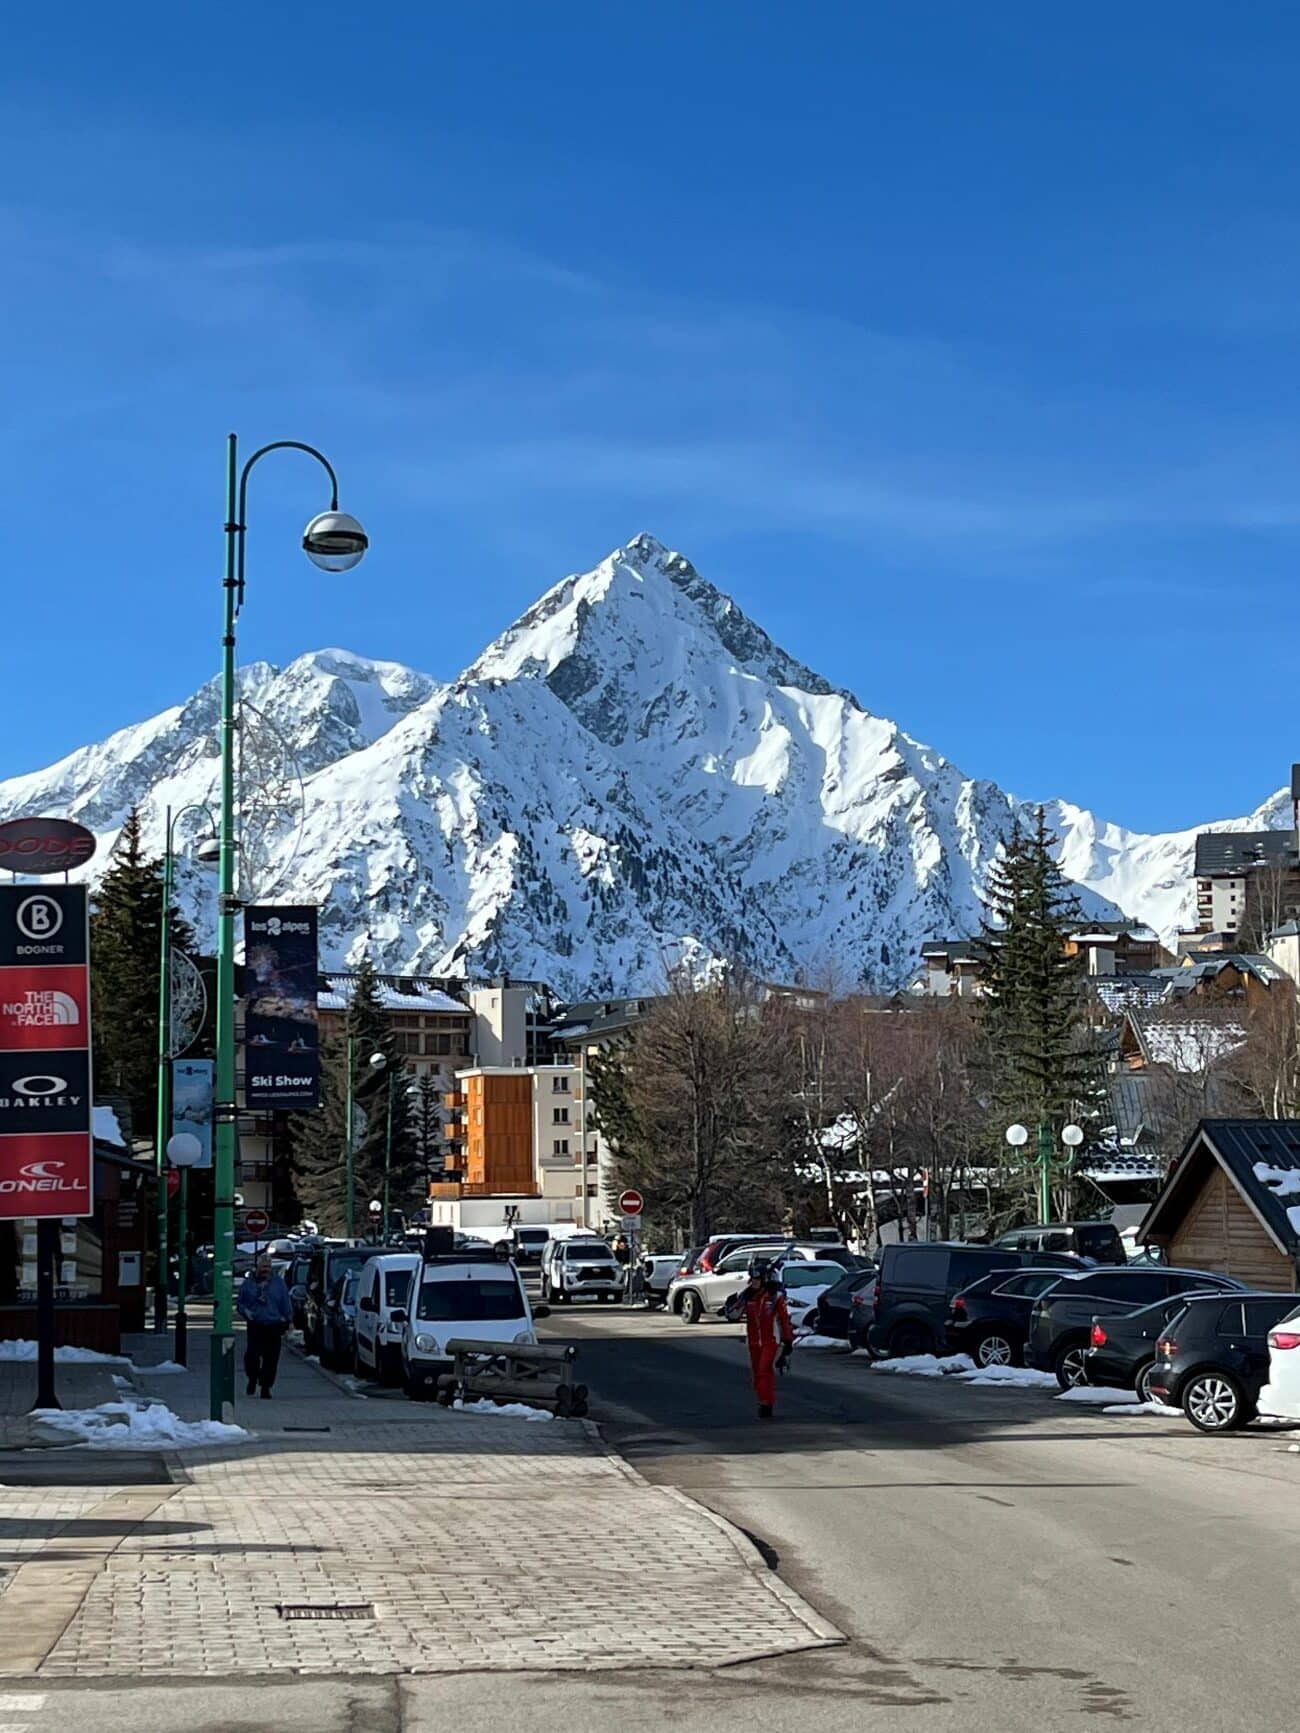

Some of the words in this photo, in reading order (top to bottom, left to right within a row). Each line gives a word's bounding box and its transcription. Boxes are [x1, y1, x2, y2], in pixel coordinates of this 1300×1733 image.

[16, 945, 64, 954] BOGNER
[25, 991, 54, 1003] THE
[3, 1003, 54, 1015] NORTH
[17, 1014, 54, 1026] FACE
[251, 1075, 272, 1086] Ski
[275, 1075, 312, 1086] Show
[0, 1096, 81, 1107] OAKLEY
